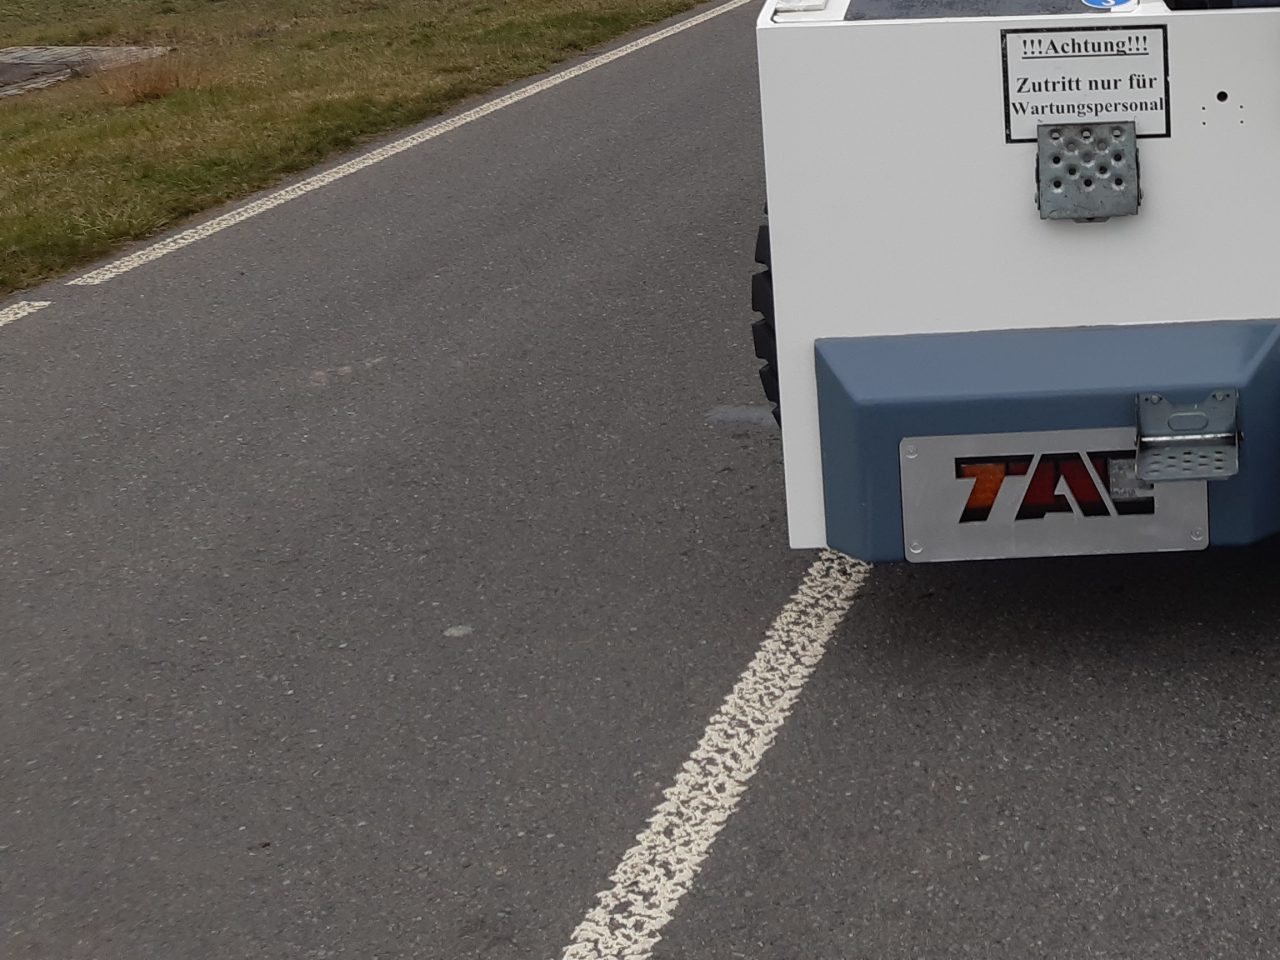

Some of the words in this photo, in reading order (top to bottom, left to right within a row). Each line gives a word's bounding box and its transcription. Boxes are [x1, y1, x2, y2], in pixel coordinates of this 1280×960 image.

[1022, 35, 1149, 58] !!!Achtung!!!
[1016, 76, 1082, 93] Zutritt
[1088, 78, 1122, 91] nur
[1128, 73, 1157, 90] für
[1011, 97, 1165, 117] Wartungspersonal
